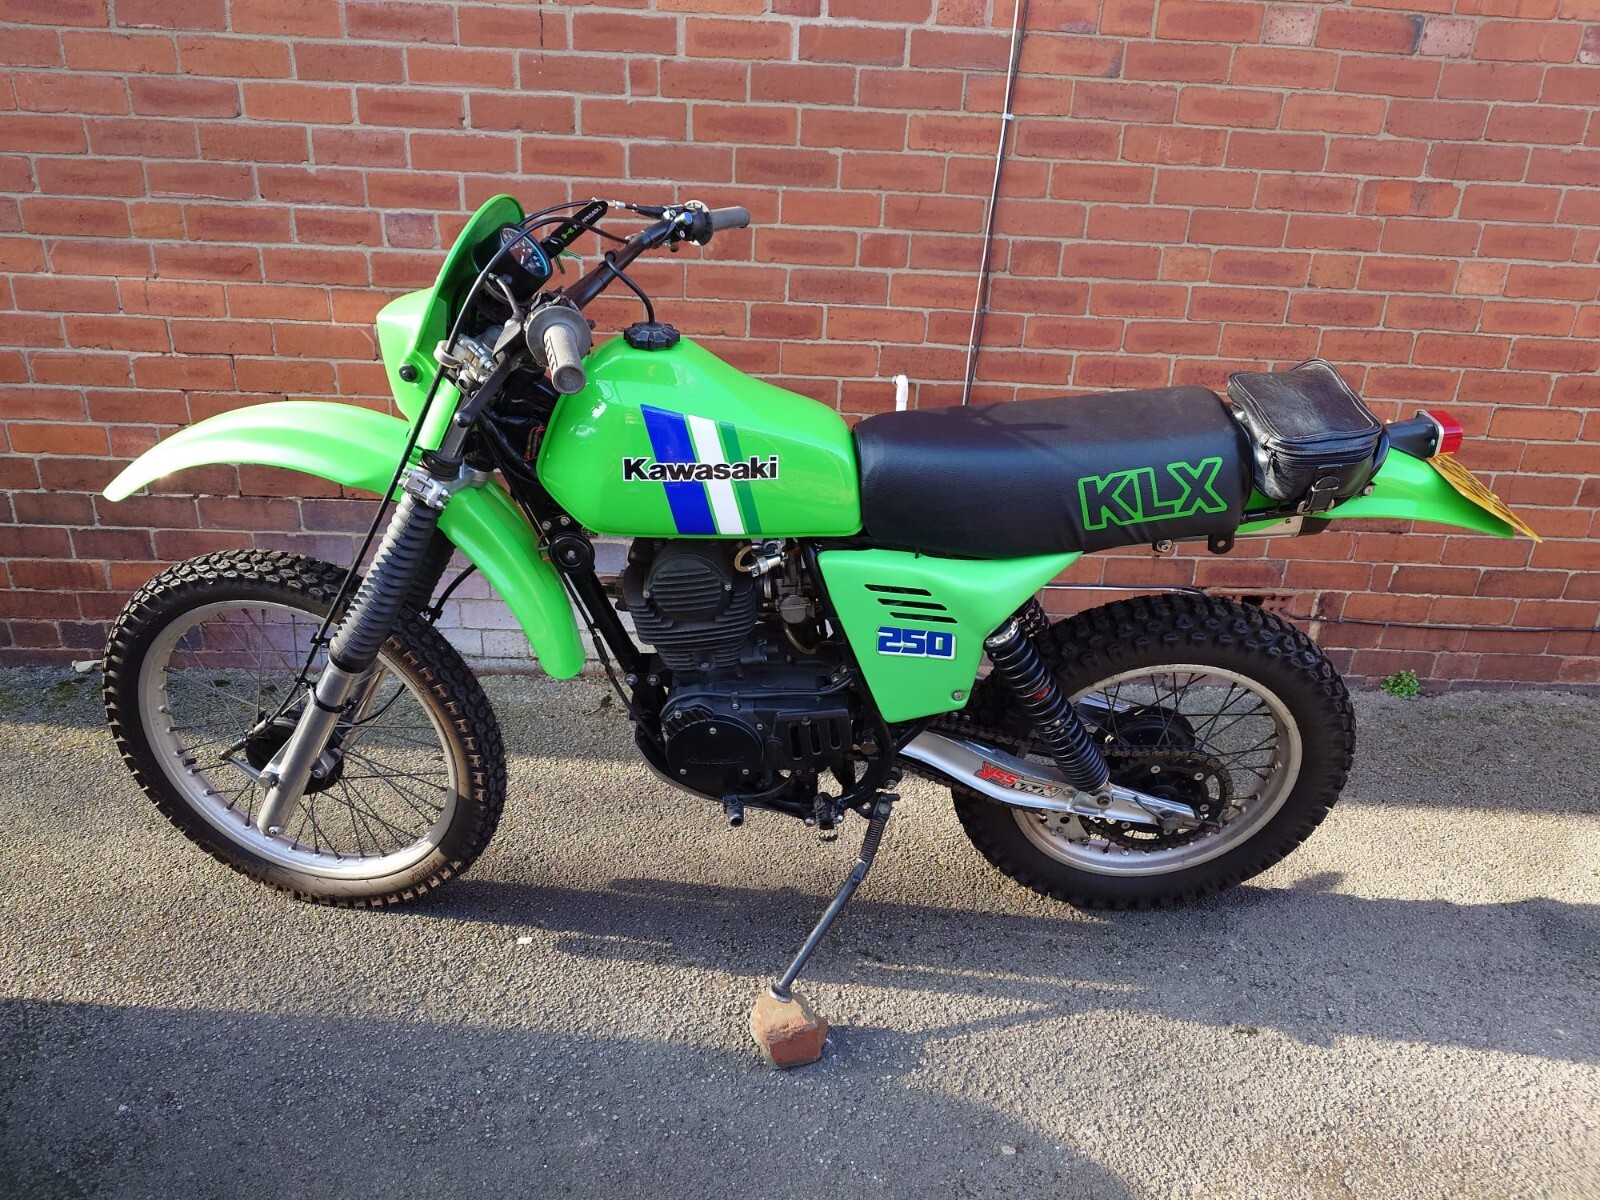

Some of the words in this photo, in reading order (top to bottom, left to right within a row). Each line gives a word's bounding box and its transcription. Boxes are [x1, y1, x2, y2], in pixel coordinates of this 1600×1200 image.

[572, 204, 603, 230] Kwasaki
[623, 456, 778, 481] Kawasaki
[1077, 456, 1228, 531] KLX
[877, 626, 956, 660] 250
